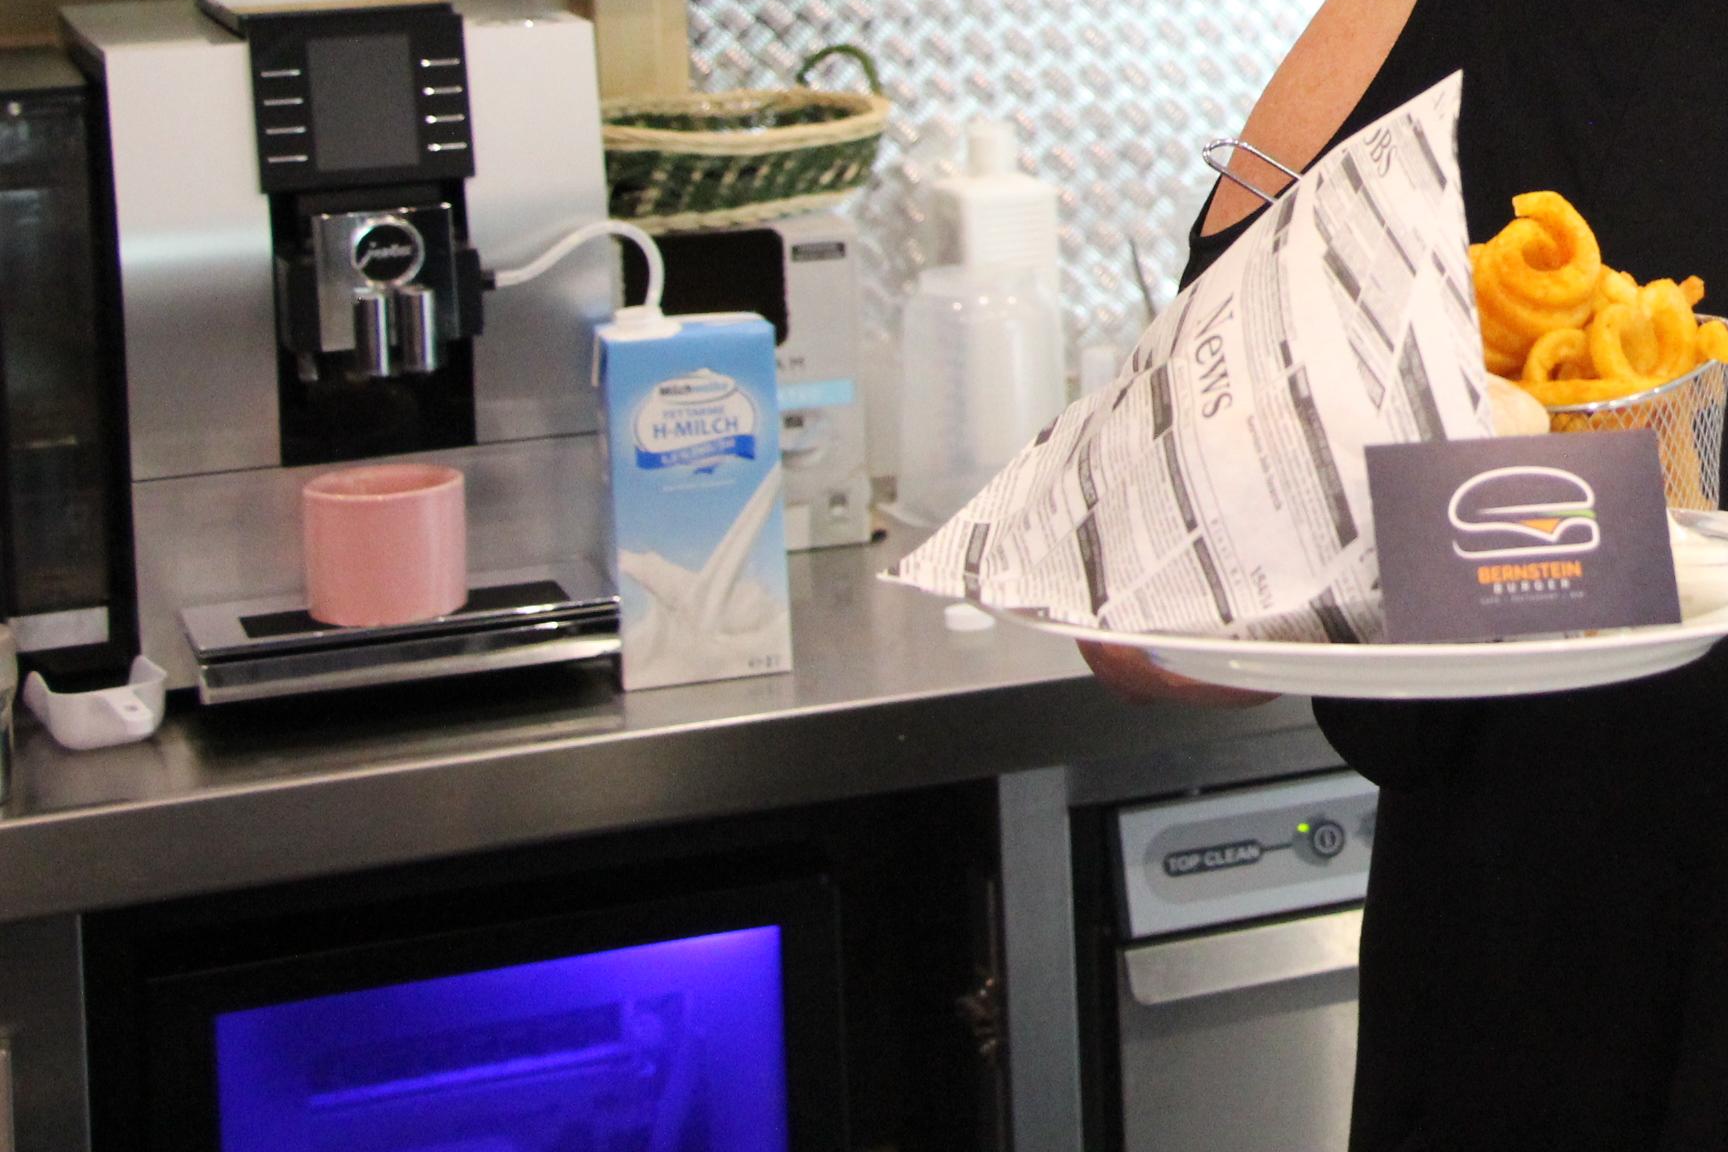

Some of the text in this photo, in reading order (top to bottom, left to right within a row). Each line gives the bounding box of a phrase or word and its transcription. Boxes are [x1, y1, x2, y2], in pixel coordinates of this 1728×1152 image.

[1194, 292, 1234, 419] News
[652, 416, 739, 439] H-MILCH
[1477, 560, 1583, 584] BERNSTEIN
[1493, 578, 1570, 594] BURGER
[1167, 845, 1262, 874] TOP CLEAN
